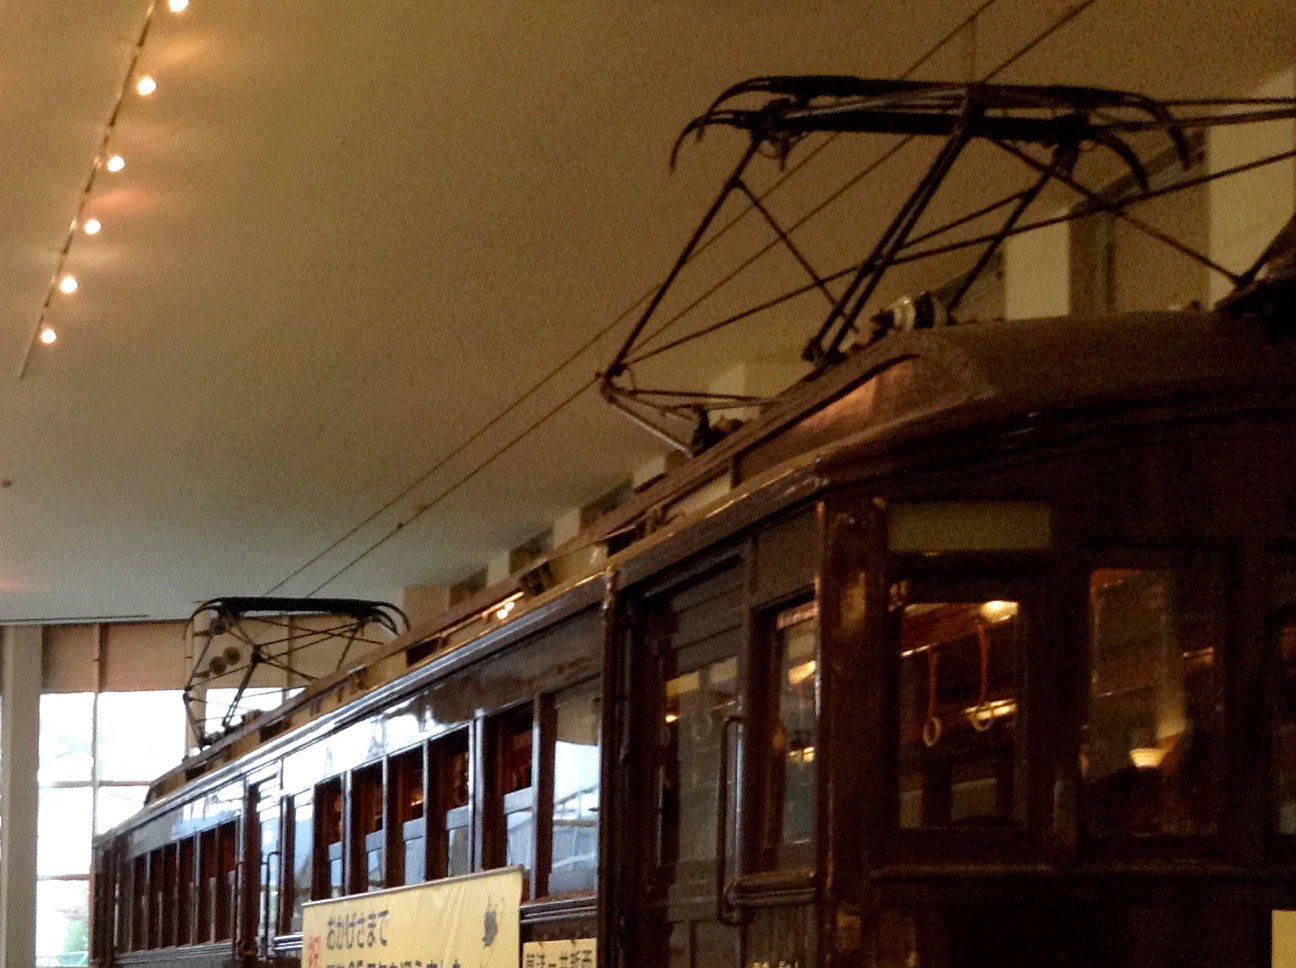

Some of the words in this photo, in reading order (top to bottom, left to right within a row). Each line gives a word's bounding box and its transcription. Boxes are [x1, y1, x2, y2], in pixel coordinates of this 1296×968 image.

[326, 910, 389, 951] おかげさまで
